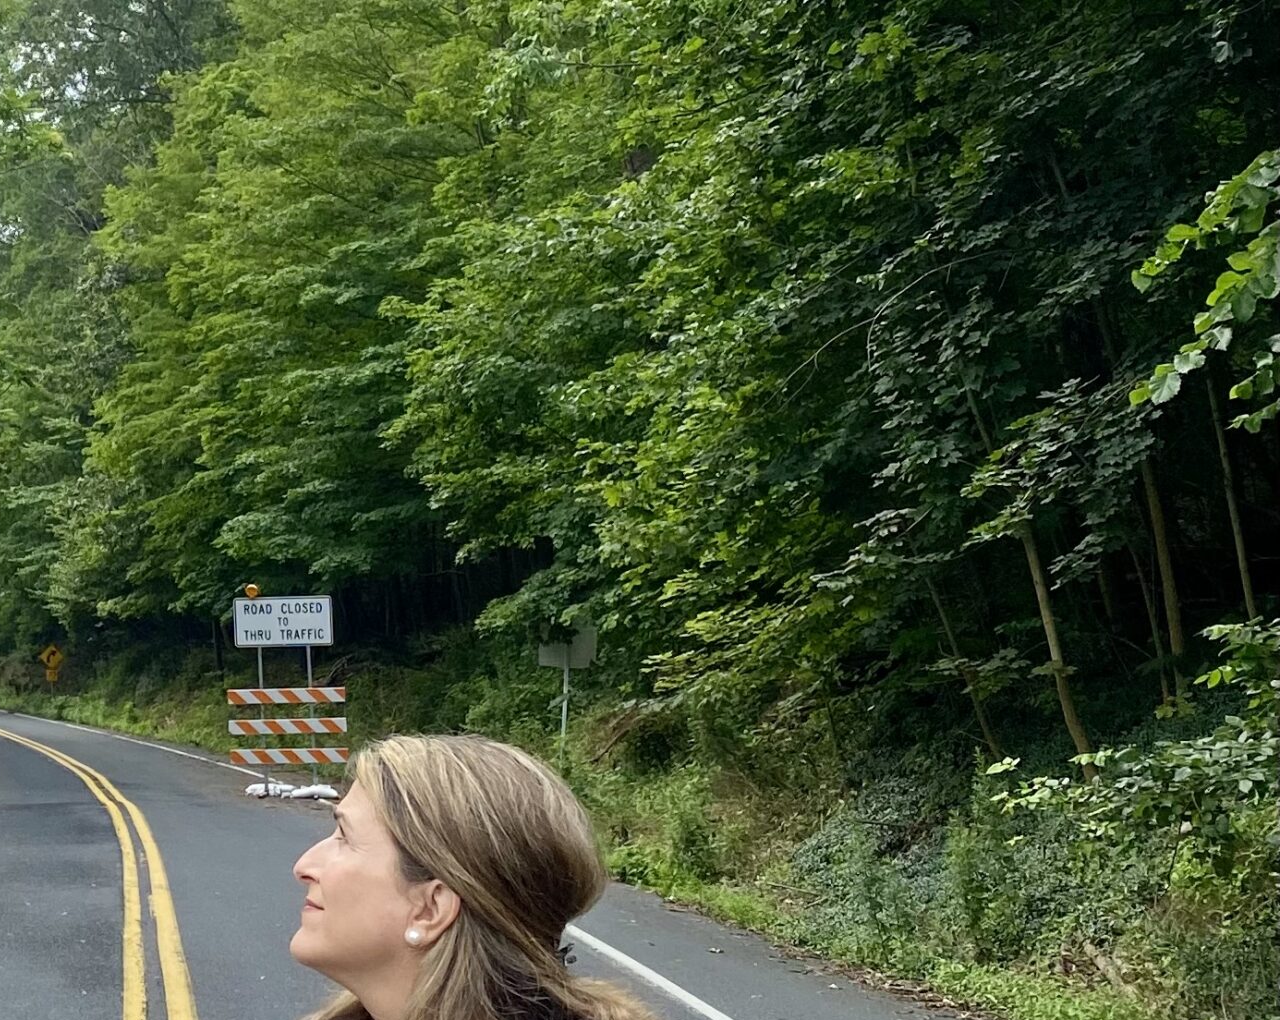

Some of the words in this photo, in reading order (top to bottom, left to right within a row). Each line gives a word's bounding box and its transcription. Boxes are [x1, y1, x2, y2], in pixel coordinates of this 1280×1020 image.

[243, 603, 273, 615] ROAD
[280, 602, 323, 614] CLOSED
[277, 616, 289, 627] TO
[244, 629, 272, 641] THRU
[280, 628, 325, 640] TRAFFIC
